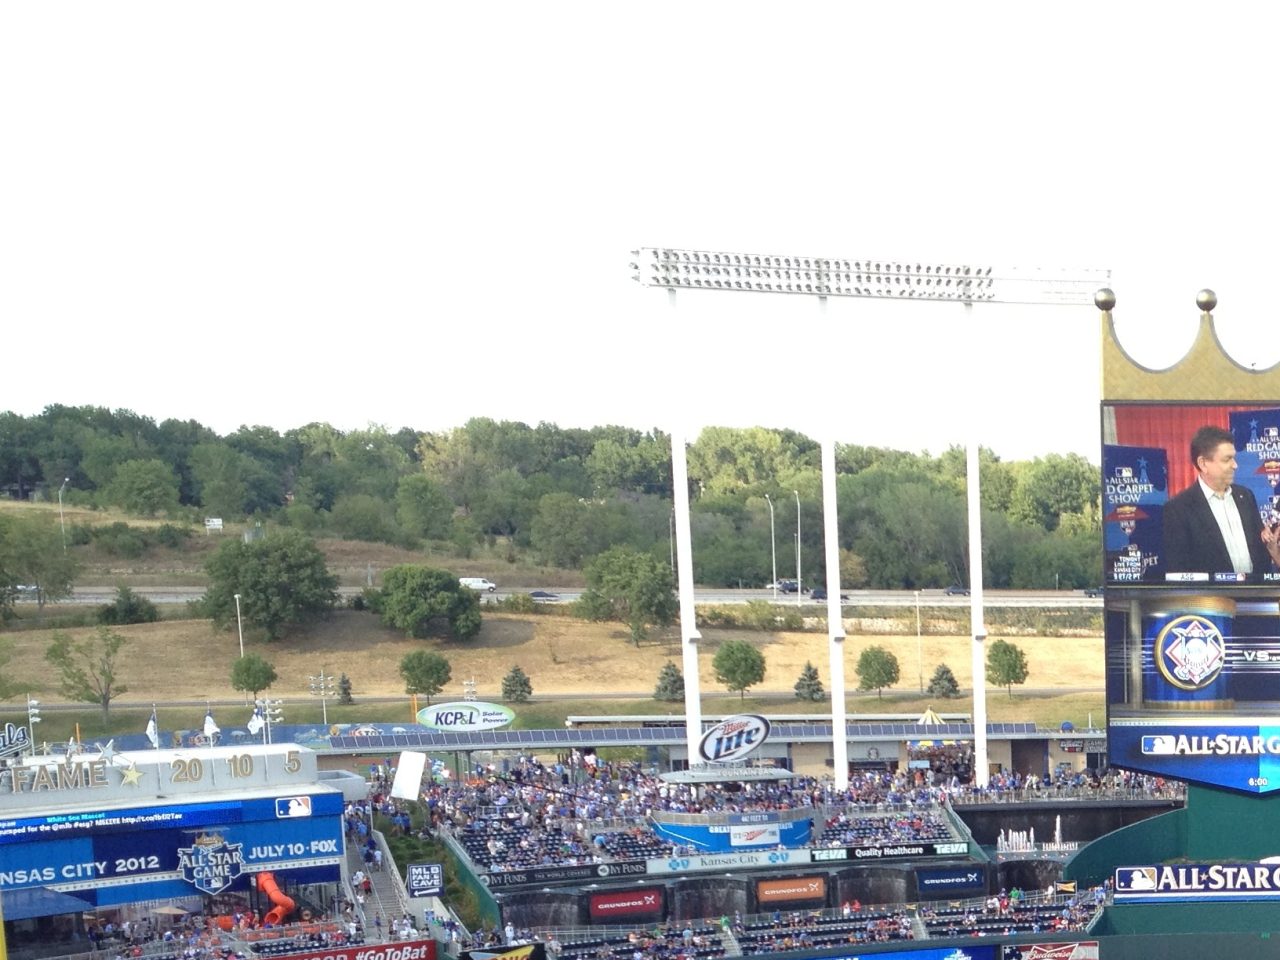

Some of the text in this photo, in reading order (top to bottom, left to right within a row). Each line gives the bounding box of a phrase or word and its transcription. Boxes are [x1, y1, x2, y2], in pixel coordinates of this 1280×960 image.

[1246, 443, 1264, 452] RED
[1116, 484, 1154, 494] CARPET
[1108, 494, 1141, 504] SHOW
[435, 712, 477, 727] KCP&L
[713, 727, 761, 760] Lite
[11, 749, 302, 794] FAME 20 10 5
[709, 825, 730, 834] GREAT
[248, 838, 338, 860] JULY 10 FOX
[811, 842, 968, 861] TEVA Quality Healthcare TEVA
[700, 853, 761, 868] Kansas City
[61, 861, 108, 879] CITY
[115, 856, 160, 873] 2012
[193, 862, 232, 879] GAME
[412, 866, 440, 875] MLB
[503, 874, 528, 885] FUNDS
[610, 865, 622, 875] IVY
[622, 863, 646, 874] FUNDS
[924, 875, 966, 884] GRUNDFOS
[412, 879, 440, 888] CAVE
[764, 887, 808, 895] GRUNDFOS
[597, 900, 644, 910] GRUNDFOS
